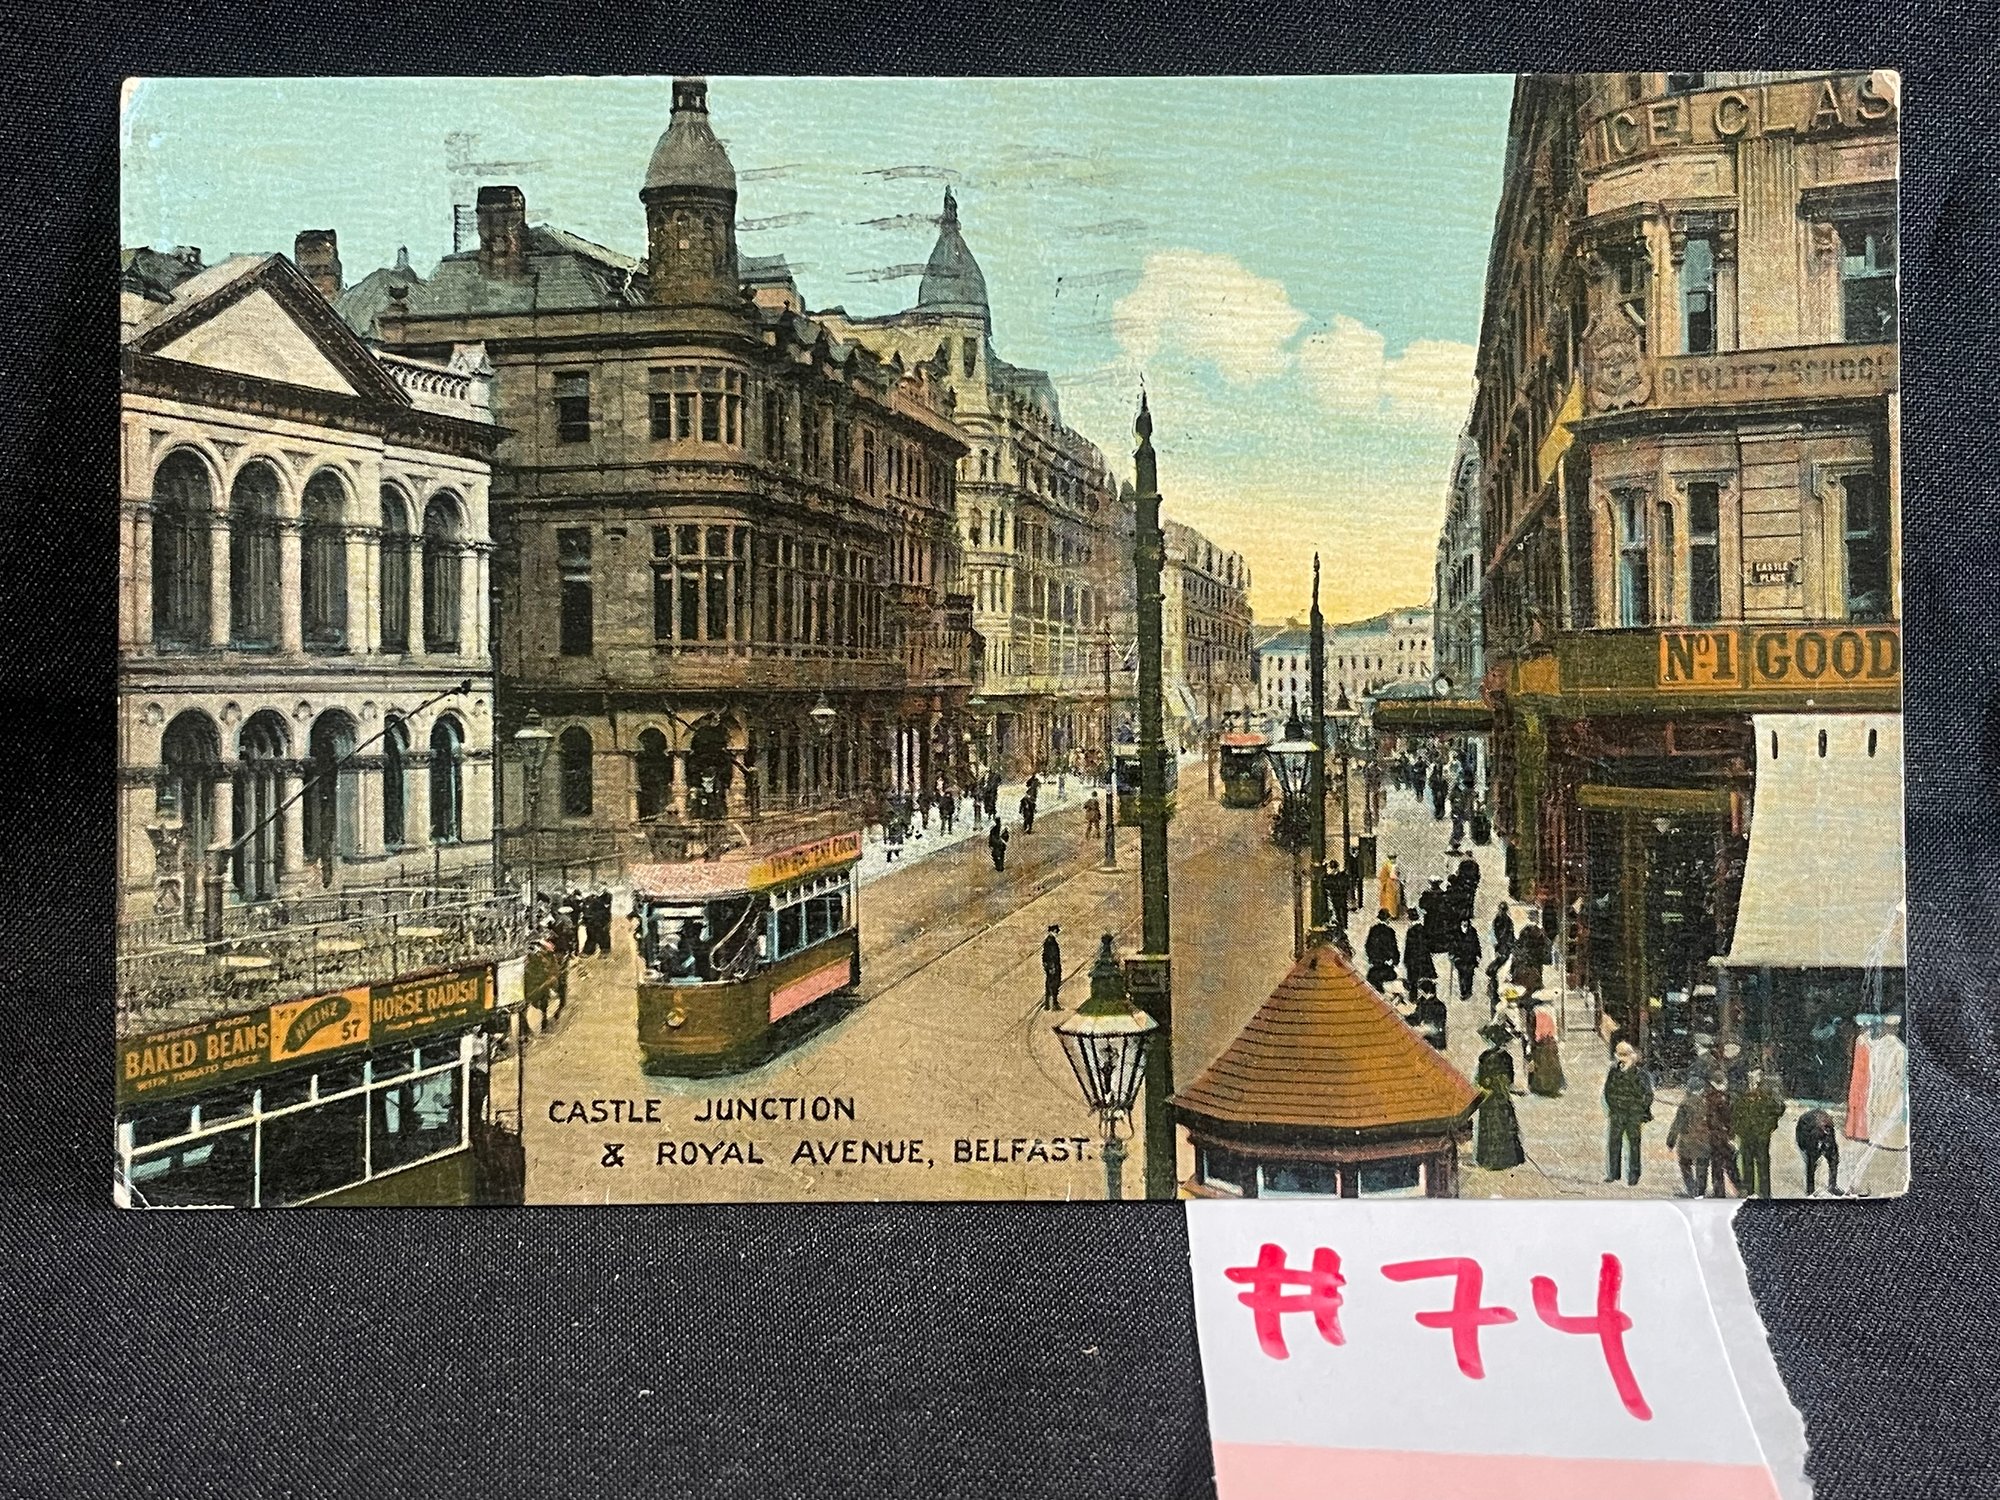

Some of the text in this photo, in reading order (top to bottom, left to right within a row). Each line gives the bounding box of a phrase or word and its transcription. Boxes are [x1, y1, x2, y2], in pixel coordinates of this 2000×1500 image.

[1755, 630, 1901, 681] GOOD
[372, 990, 424, 1025] HORSE
[426, 977, 479, 1011] RADISH
[341, 1019, 362, 1041] 57
[125, 1021, 270, 1080] BAKED BEANS
[548, 1094, 856, 1124] CASTLE JUNCTION
[600, 1136, 1094, 1169] & ROYAL AVENUE, BELFAST.
